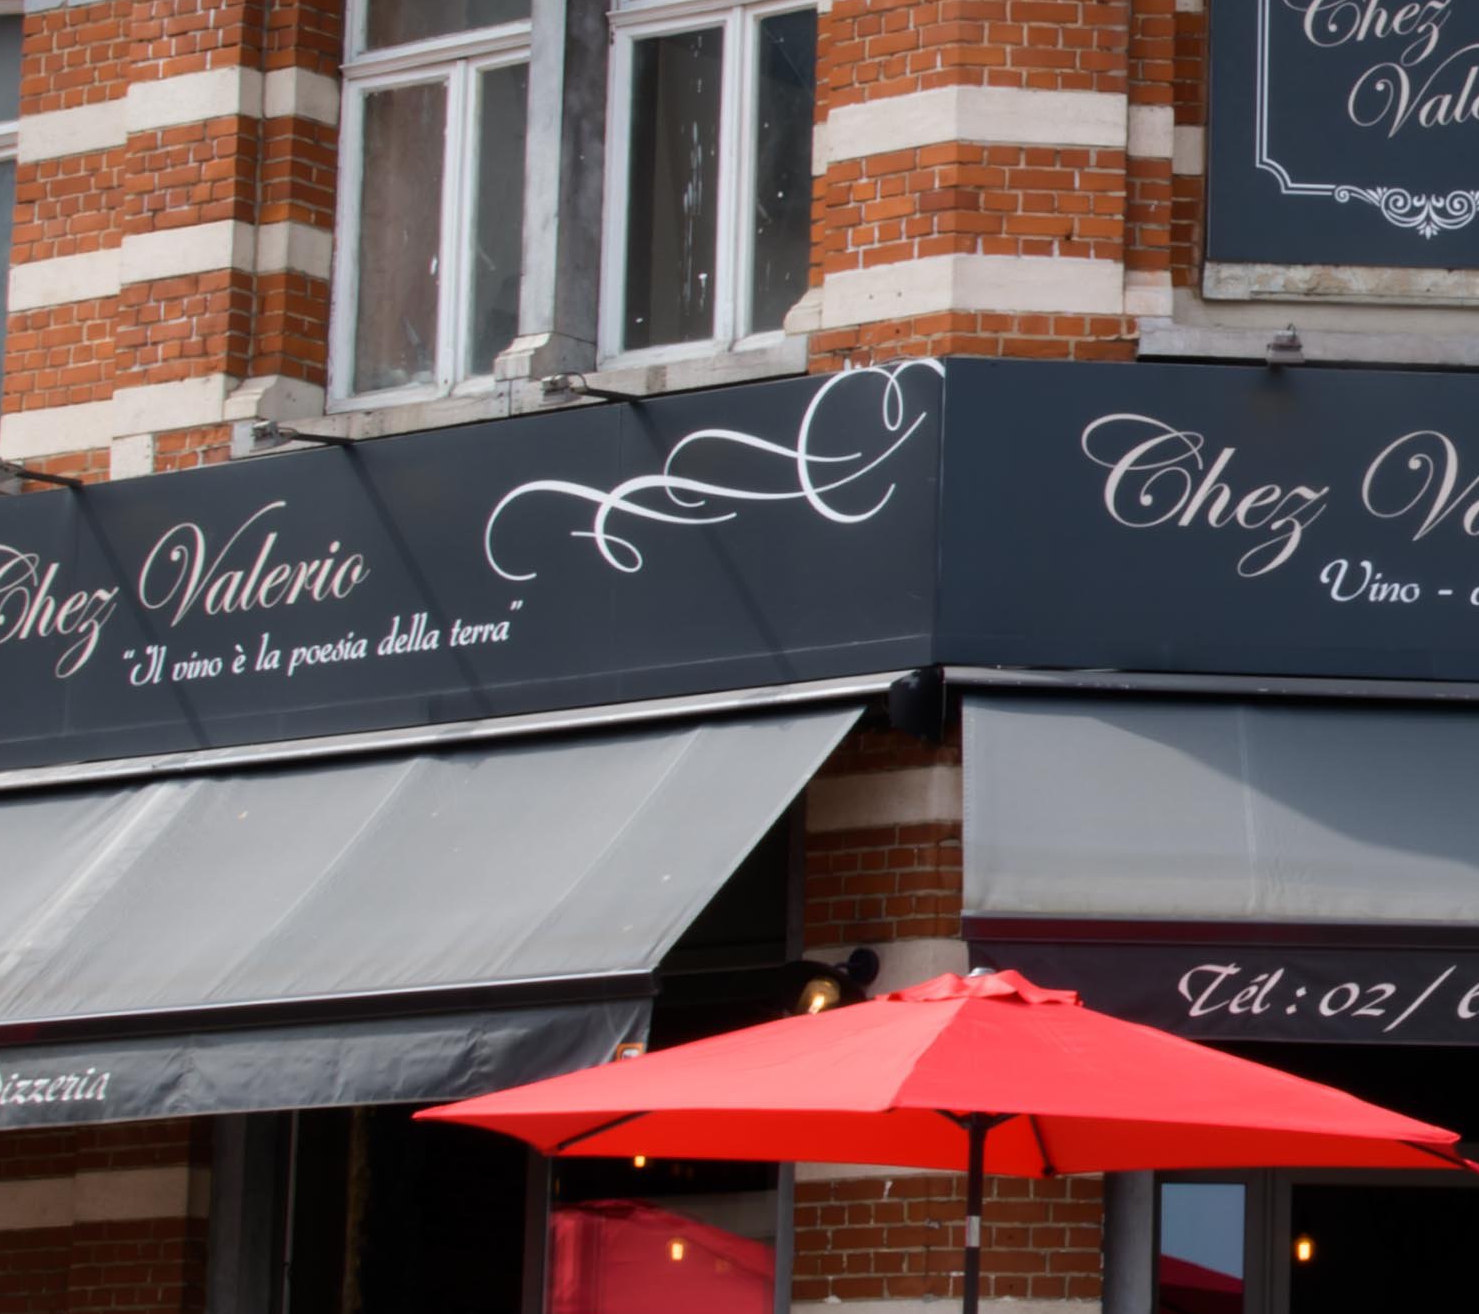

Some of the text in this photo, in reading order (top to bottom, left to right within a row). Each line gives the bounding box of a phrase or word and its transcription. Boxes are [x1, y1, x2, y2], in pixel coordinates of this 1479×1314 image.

[1081, 413, 1328, 578] Chez
[138, 500, 372, 628] Valerio
[1320, 558, 1421, 604] Vino
[171, 650, 223, 682] vino
[230, 643, 247, 675] è
[254, 631, 282, 672] la
[286, 630, 369, 678] poesia
[376, 611, 441, 657] della
